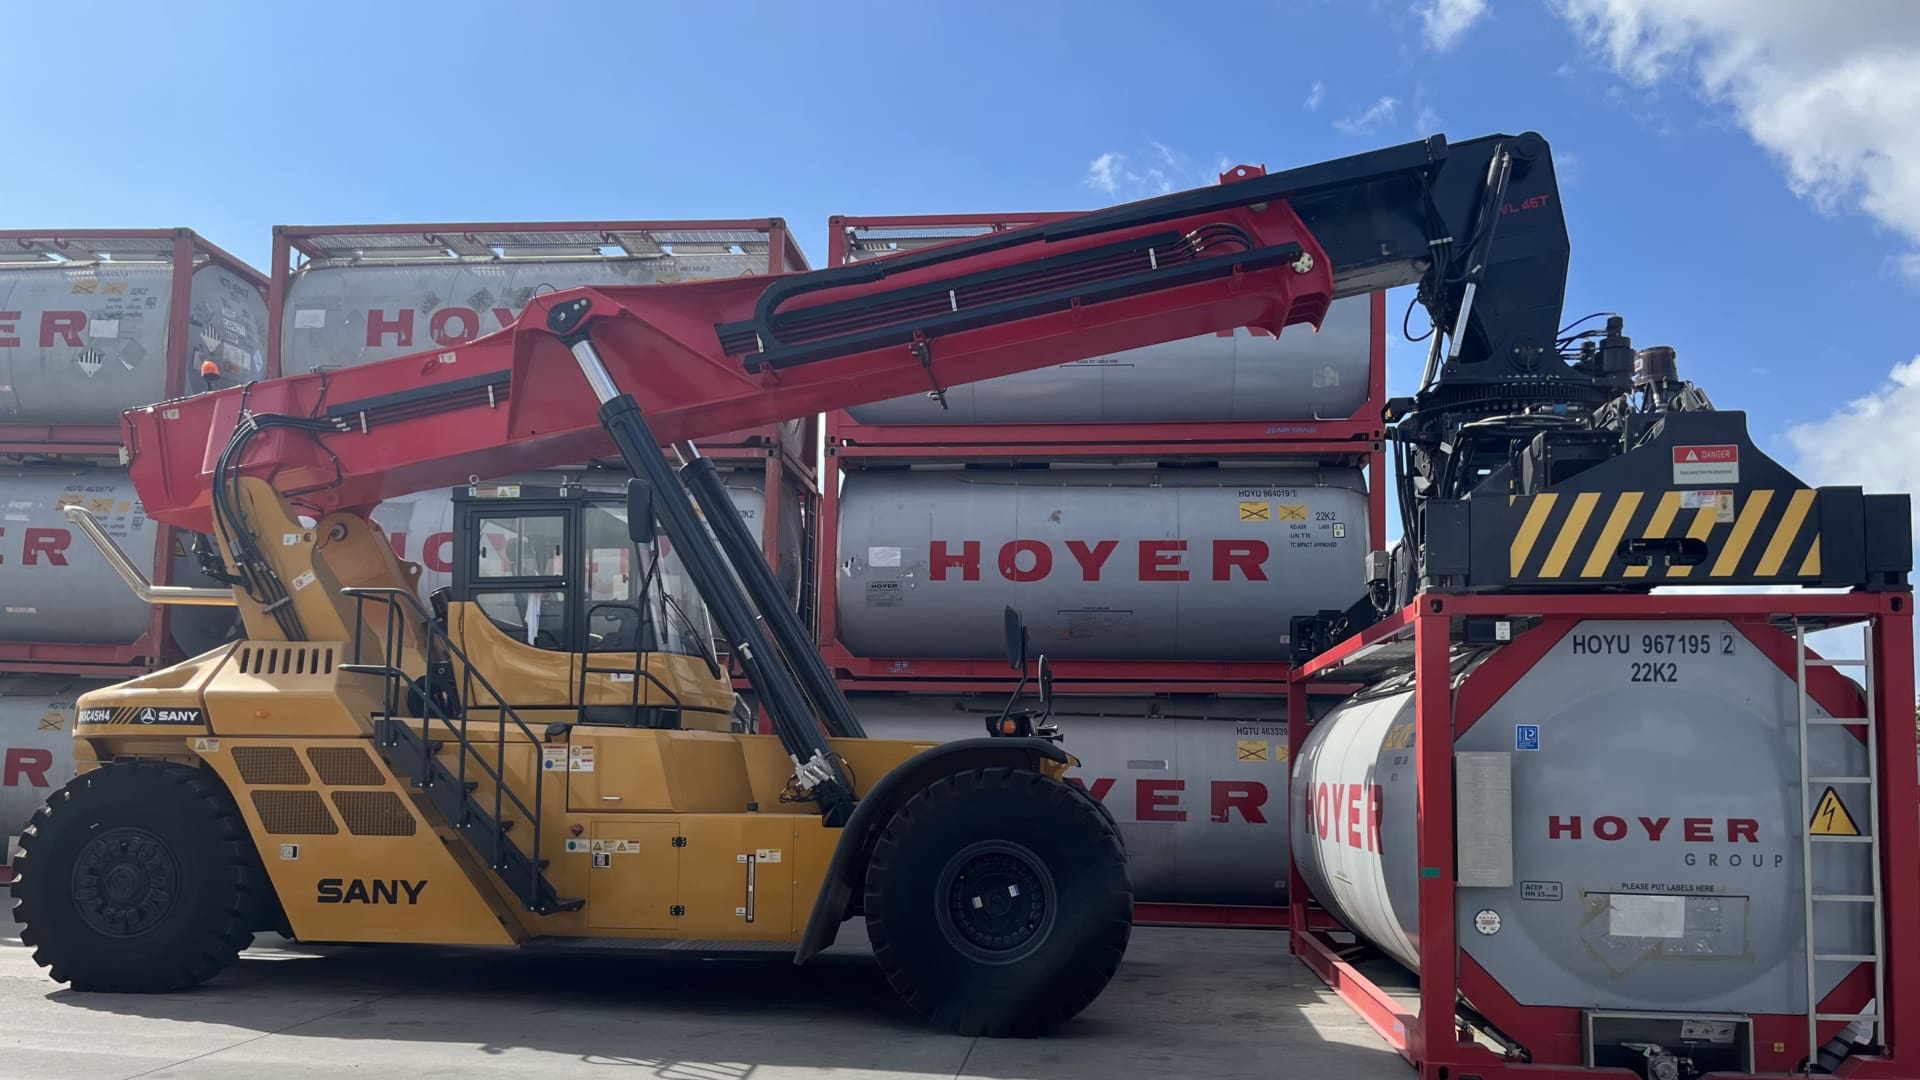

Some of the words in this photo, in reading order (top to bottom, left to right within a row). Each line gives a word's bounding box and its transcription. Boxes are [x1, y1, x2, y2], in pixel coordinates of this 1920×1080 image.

[1701, 450, 1730, 459] DANGER
[1238, 489, 1262, 498] HOYU
[1263, 489, 1290, 498] 964019
[1315, 511, 1336, 521] 22K2
[929, 539, 1270, 582] HOYER
[1573, 634, 1630, 655] HOYU
[1642, 634, 1711, 655] 967195
[1722, 634, 1733, 655] 2
[1631, 662, 1678, 683] 22K2
[158, 711, 199, 721] SANY
[1236, 727, 1259, 736] HGTU
[1305, 782, 1384, 856] HOYER
[1549, 815, 1760, 843] HOYER
[1684, 853, 1783, 868] GROUP
[317, 878, 428, 905] SANY
[1621, 882, 1649, 891] PLEASE
[1651, 883, 1665, 891] PUT
[1666, 883, 1694, 892] LABELS
[1695, 884, 1715, 892] HERE
